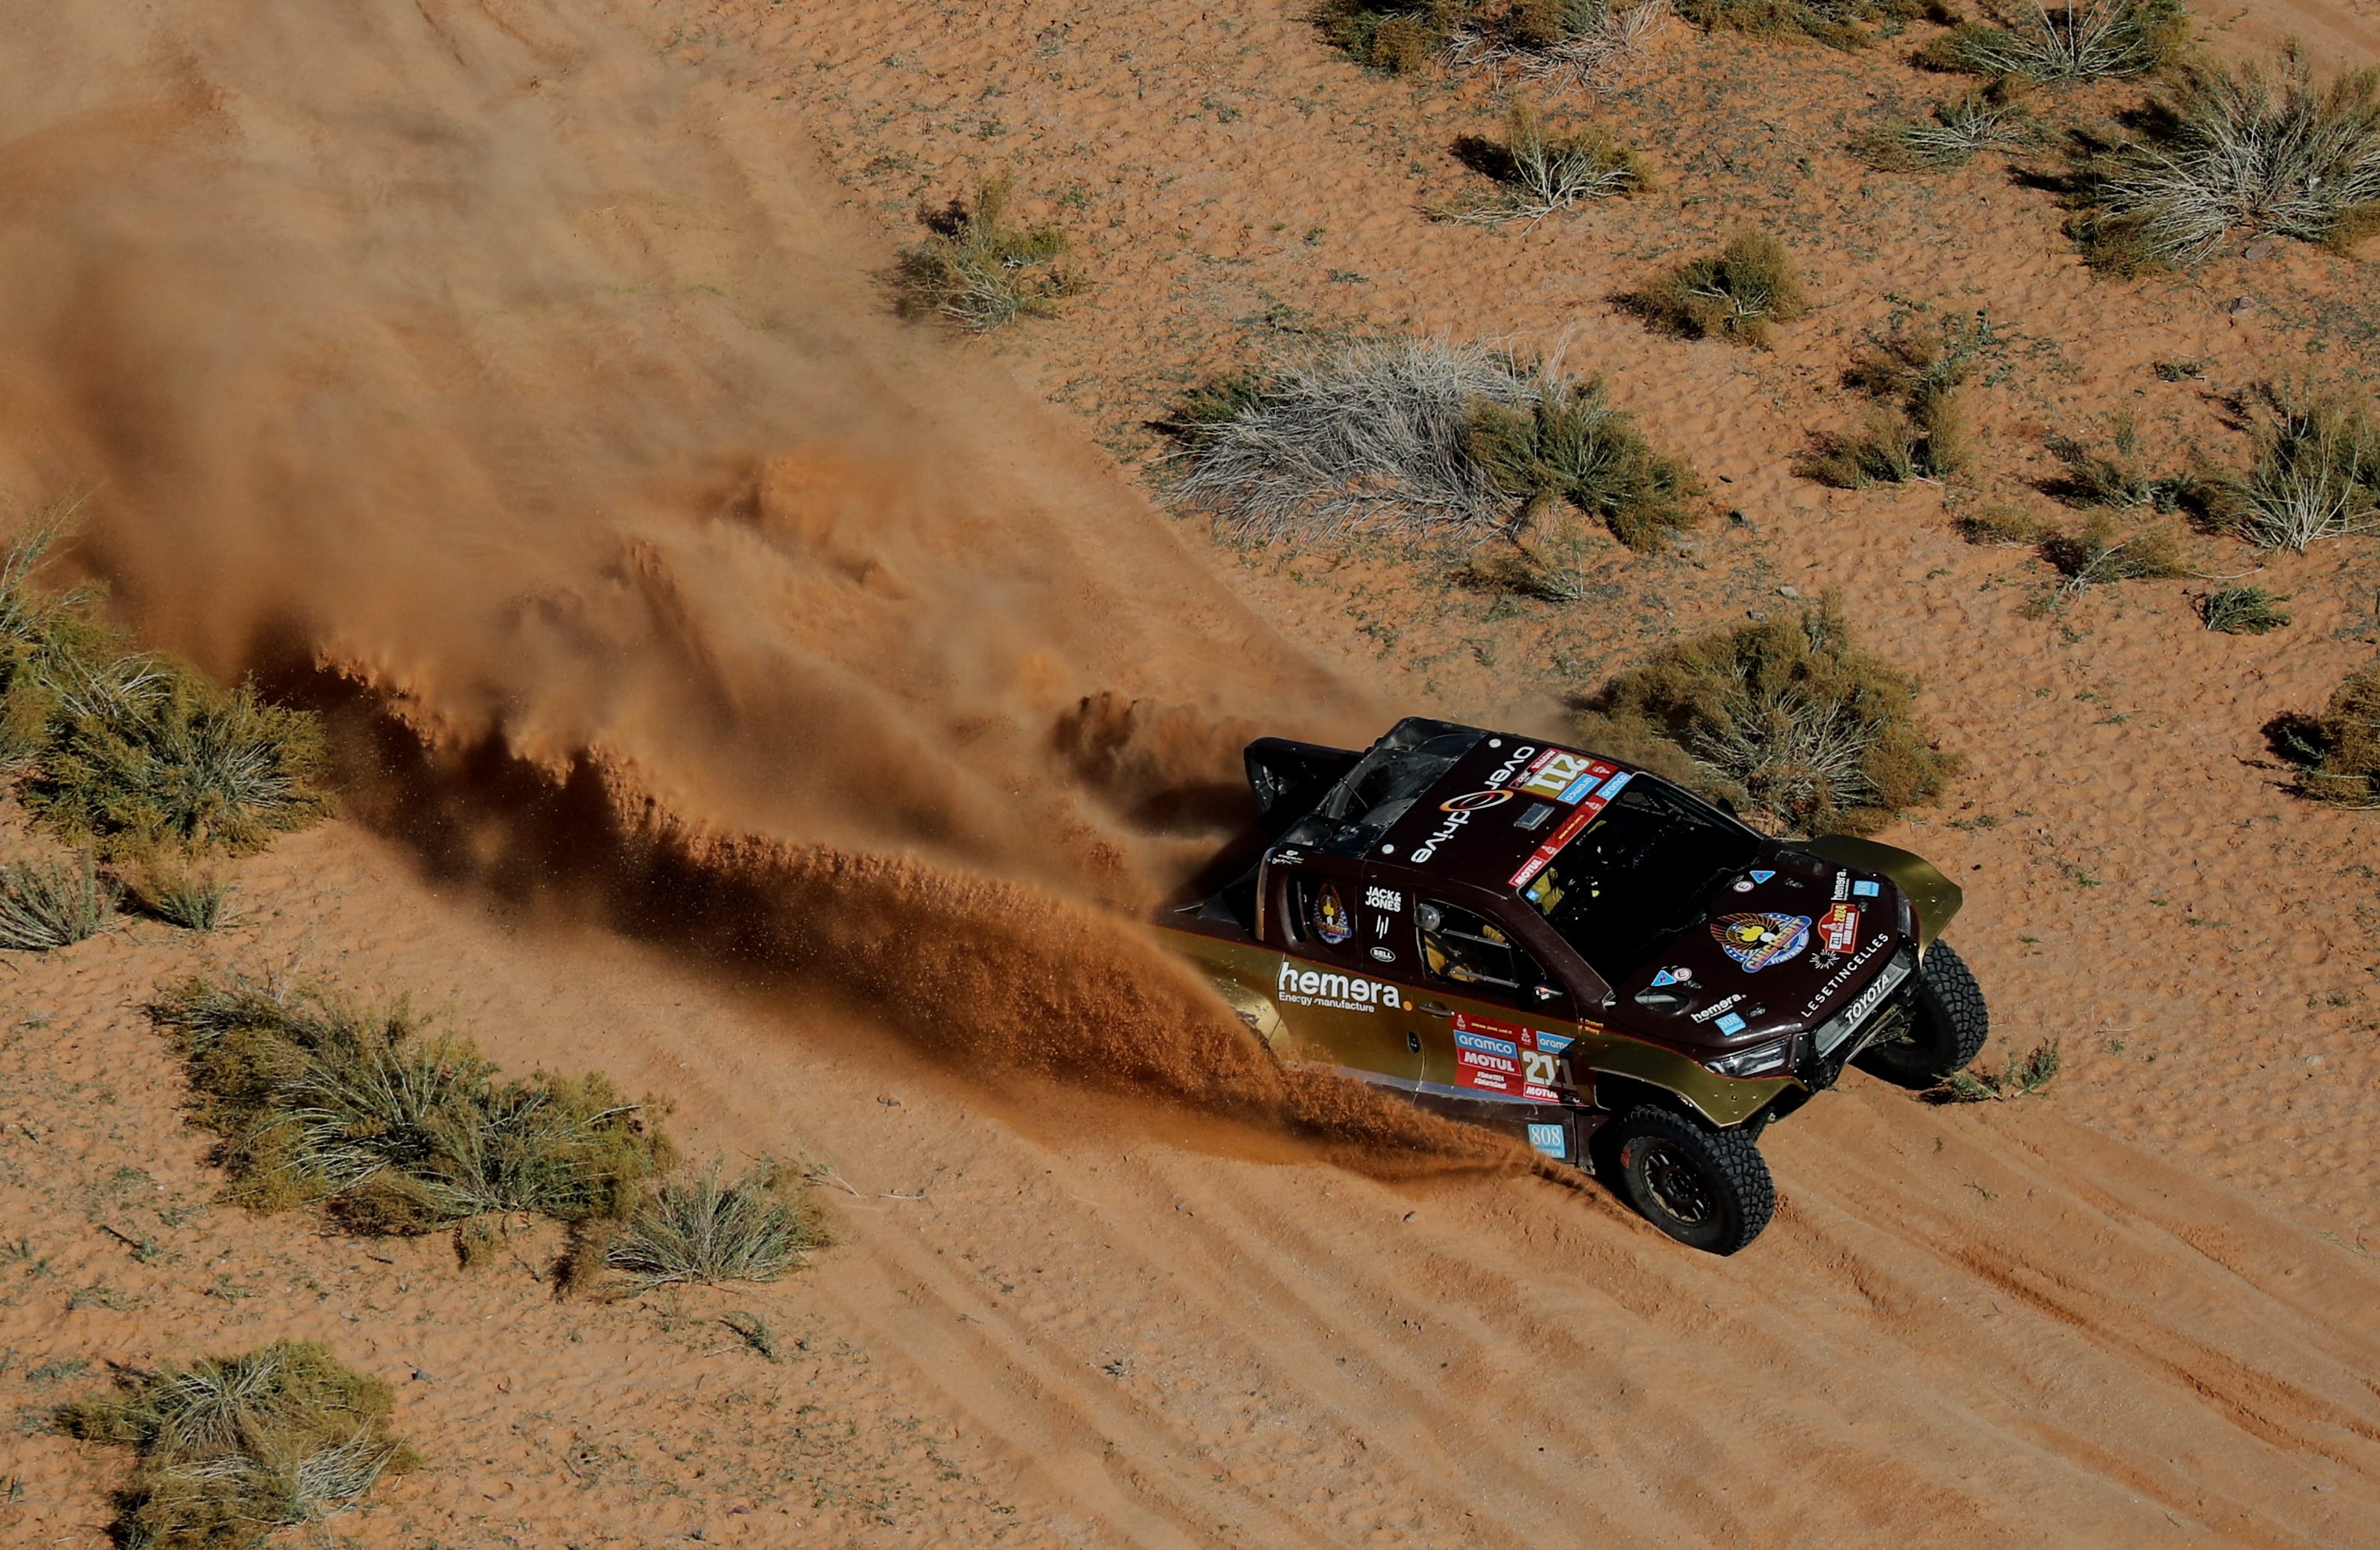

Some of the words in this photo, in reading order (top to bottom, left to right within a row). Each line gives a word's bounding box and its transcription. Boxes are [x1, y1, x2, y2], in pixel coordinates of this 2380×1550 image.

[1532, 751, 1556, 770] MOTUL
[1527, 753, 1589, 791] 211
[1565, 777, 1592, 801] aramco
[1601, 775, 1628, 797] aramco
[1514, 859, 1543, 886] MOTUL
[1365, 895, 1401, 913] JONES
[1833, 905, 1847, 922] 2024
[1373, 949, 1393, 960] BELL
[1801, 933, 1889, 1018] LESETINCELLES
[1278, 991, 1313, 1006] Energy
[1313, 997, 1375, 1013] manufacture
[1845, 974, 1890, 1024] TOYOTA
[1459, 1035, 1513, 1054] aramco
[1464, 1051, 1515, 1072] MOTUL
[1522, 1051, 1577, 1090] 211
[1526, 1087, 1559, 1099] MOTUL
[1531, 1126, 1561, 1146] 808
